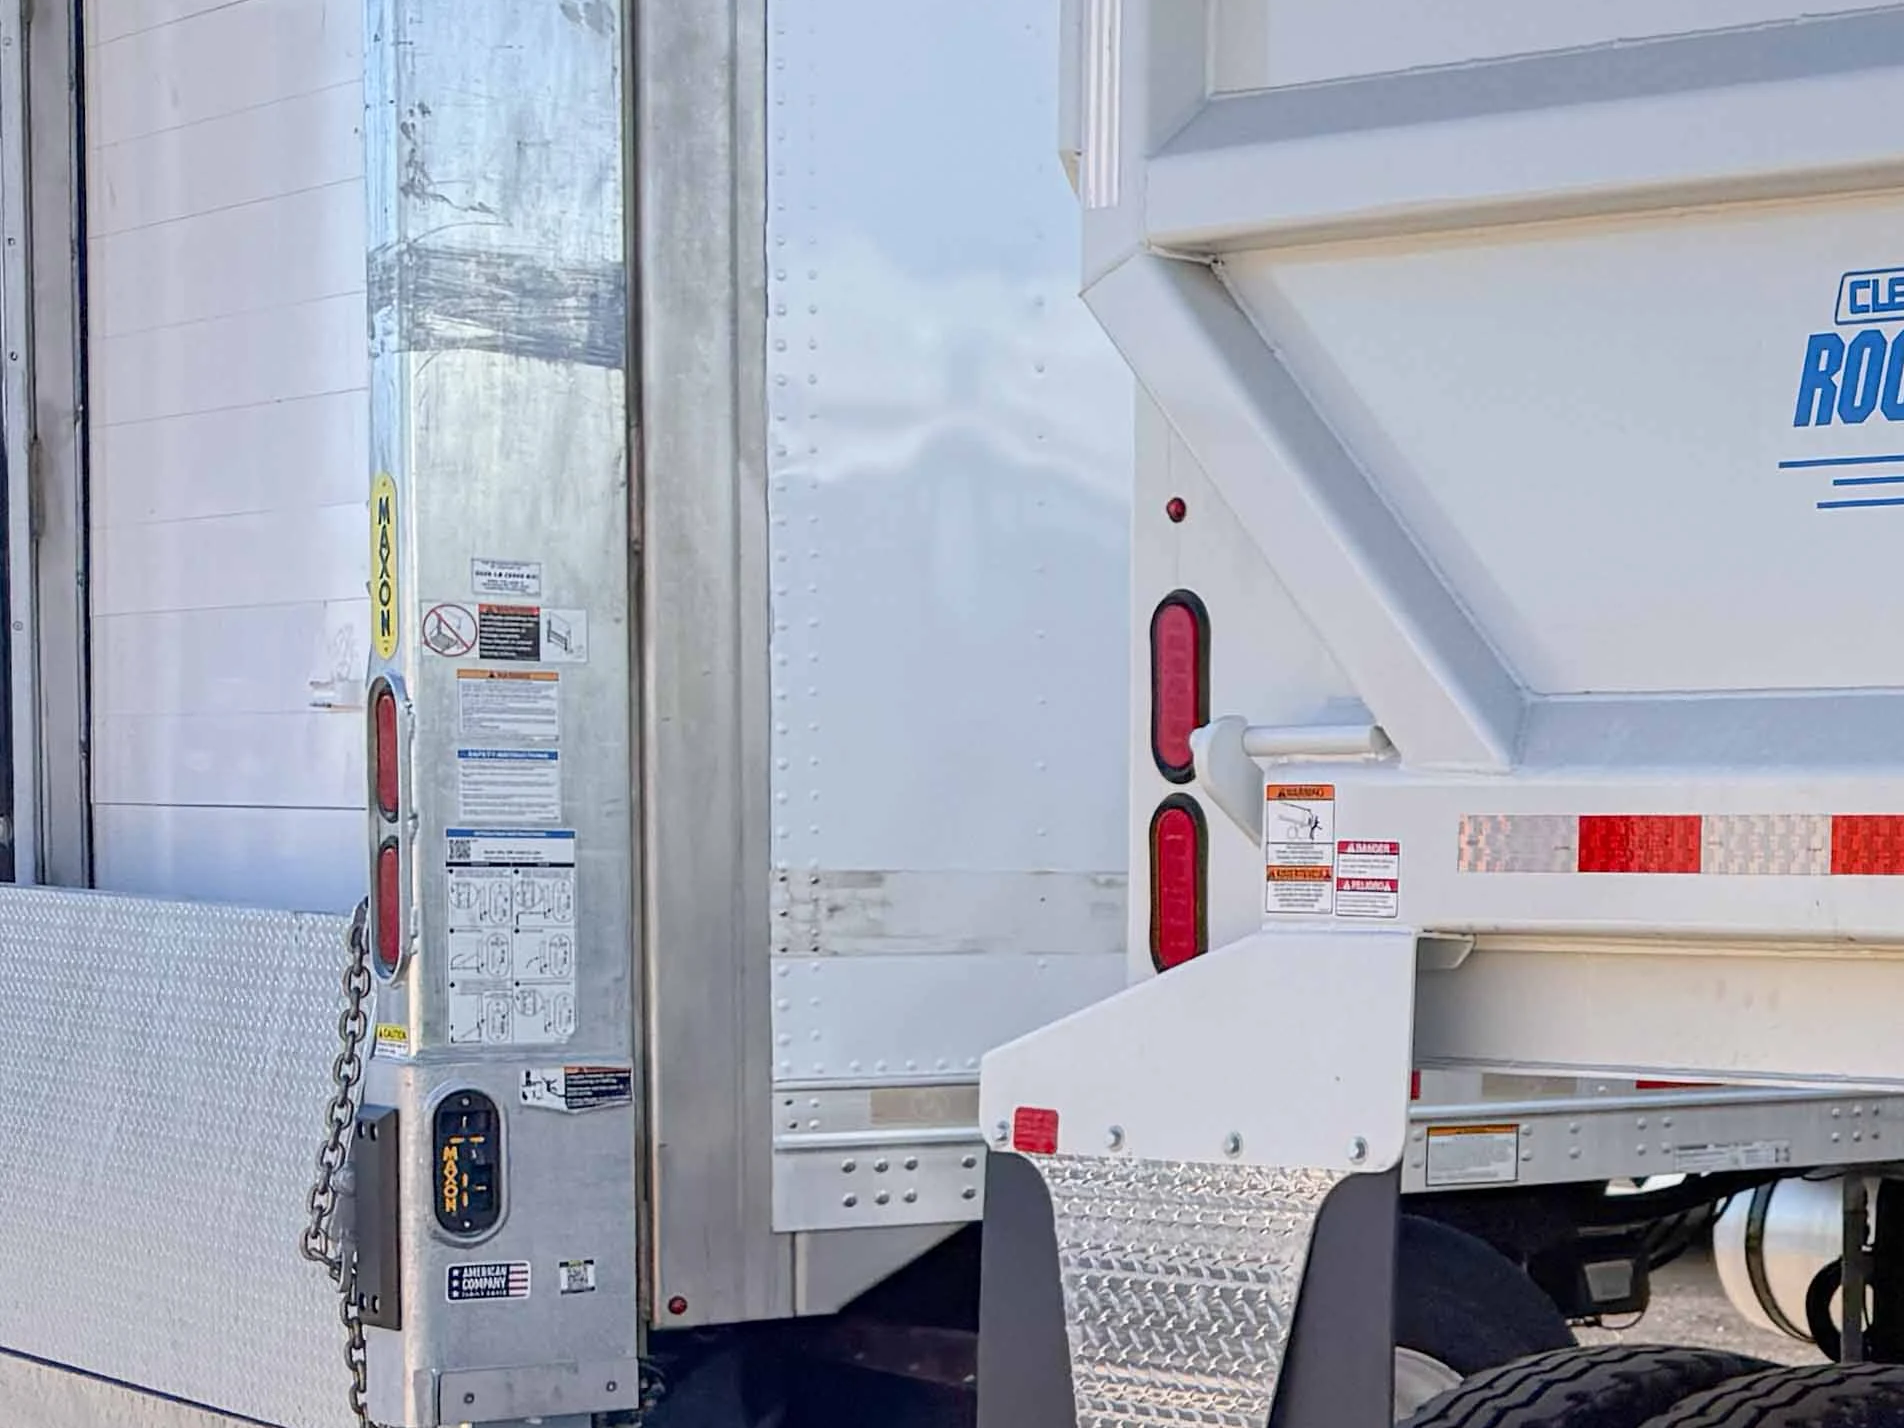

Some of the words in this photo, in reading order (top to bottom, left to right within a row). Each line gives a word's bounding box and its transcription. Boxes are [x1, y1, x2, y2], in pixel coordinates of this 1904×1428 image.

[377, 495, 392, 638] MAXON
[443, 1145, 459, 1213] MAXON
[462, 1277, 507, 1291] COMPANY
[463, 1265, 508, 1278] AMERICAN
